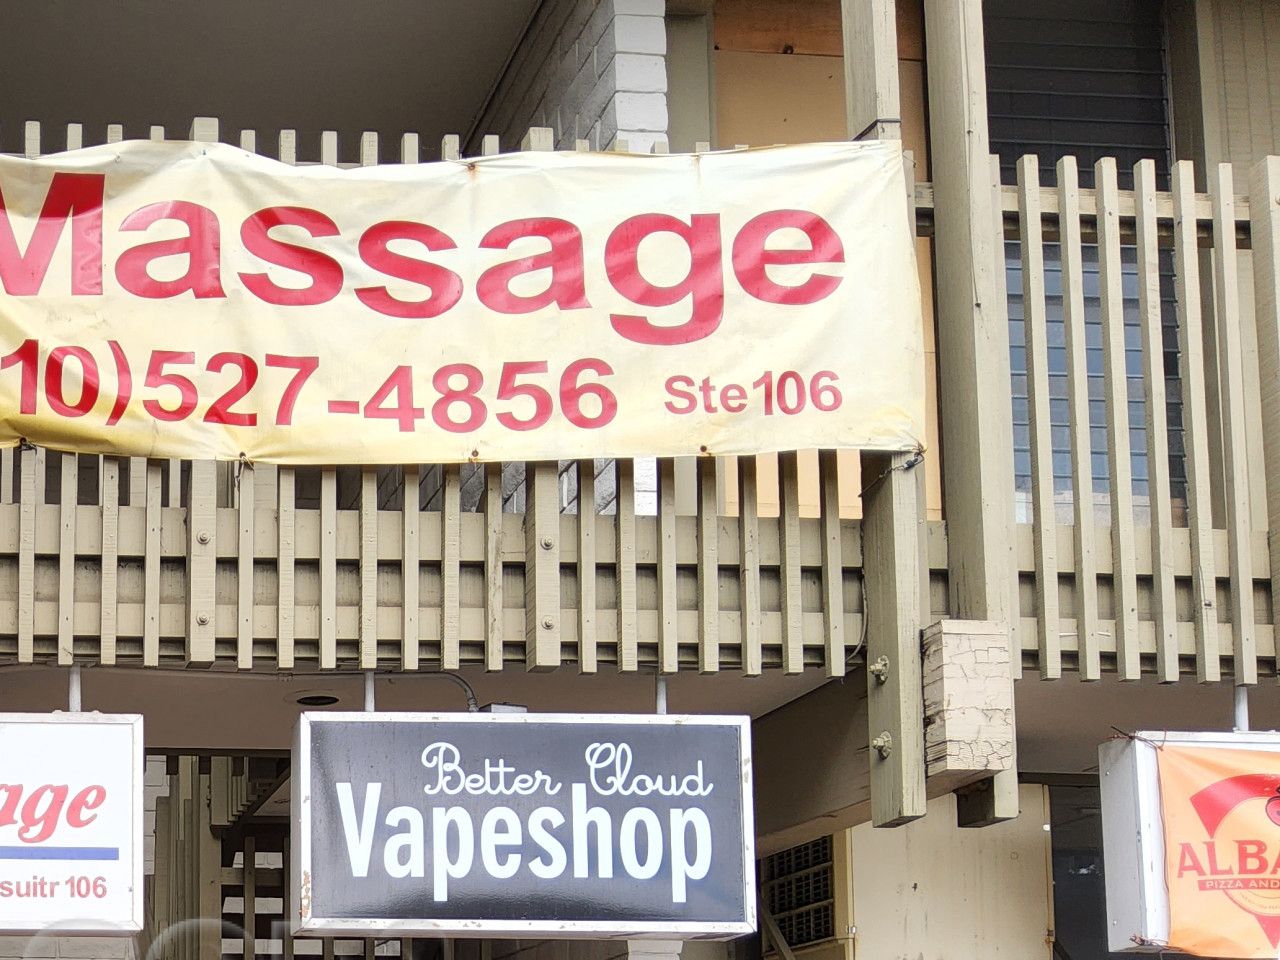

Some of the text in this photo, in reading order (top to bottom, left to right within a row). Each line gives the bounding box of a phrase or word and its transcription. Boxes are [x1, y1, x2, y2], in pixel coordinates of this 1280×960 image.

[421, 742, 714, 797] Better Cloud
[336, 782, 713, 903] Vapeshop
[0, 876, 60, 899] suitr
[65, 876, 107, 898] 106
[1249, 880, 1280, 888] AND
